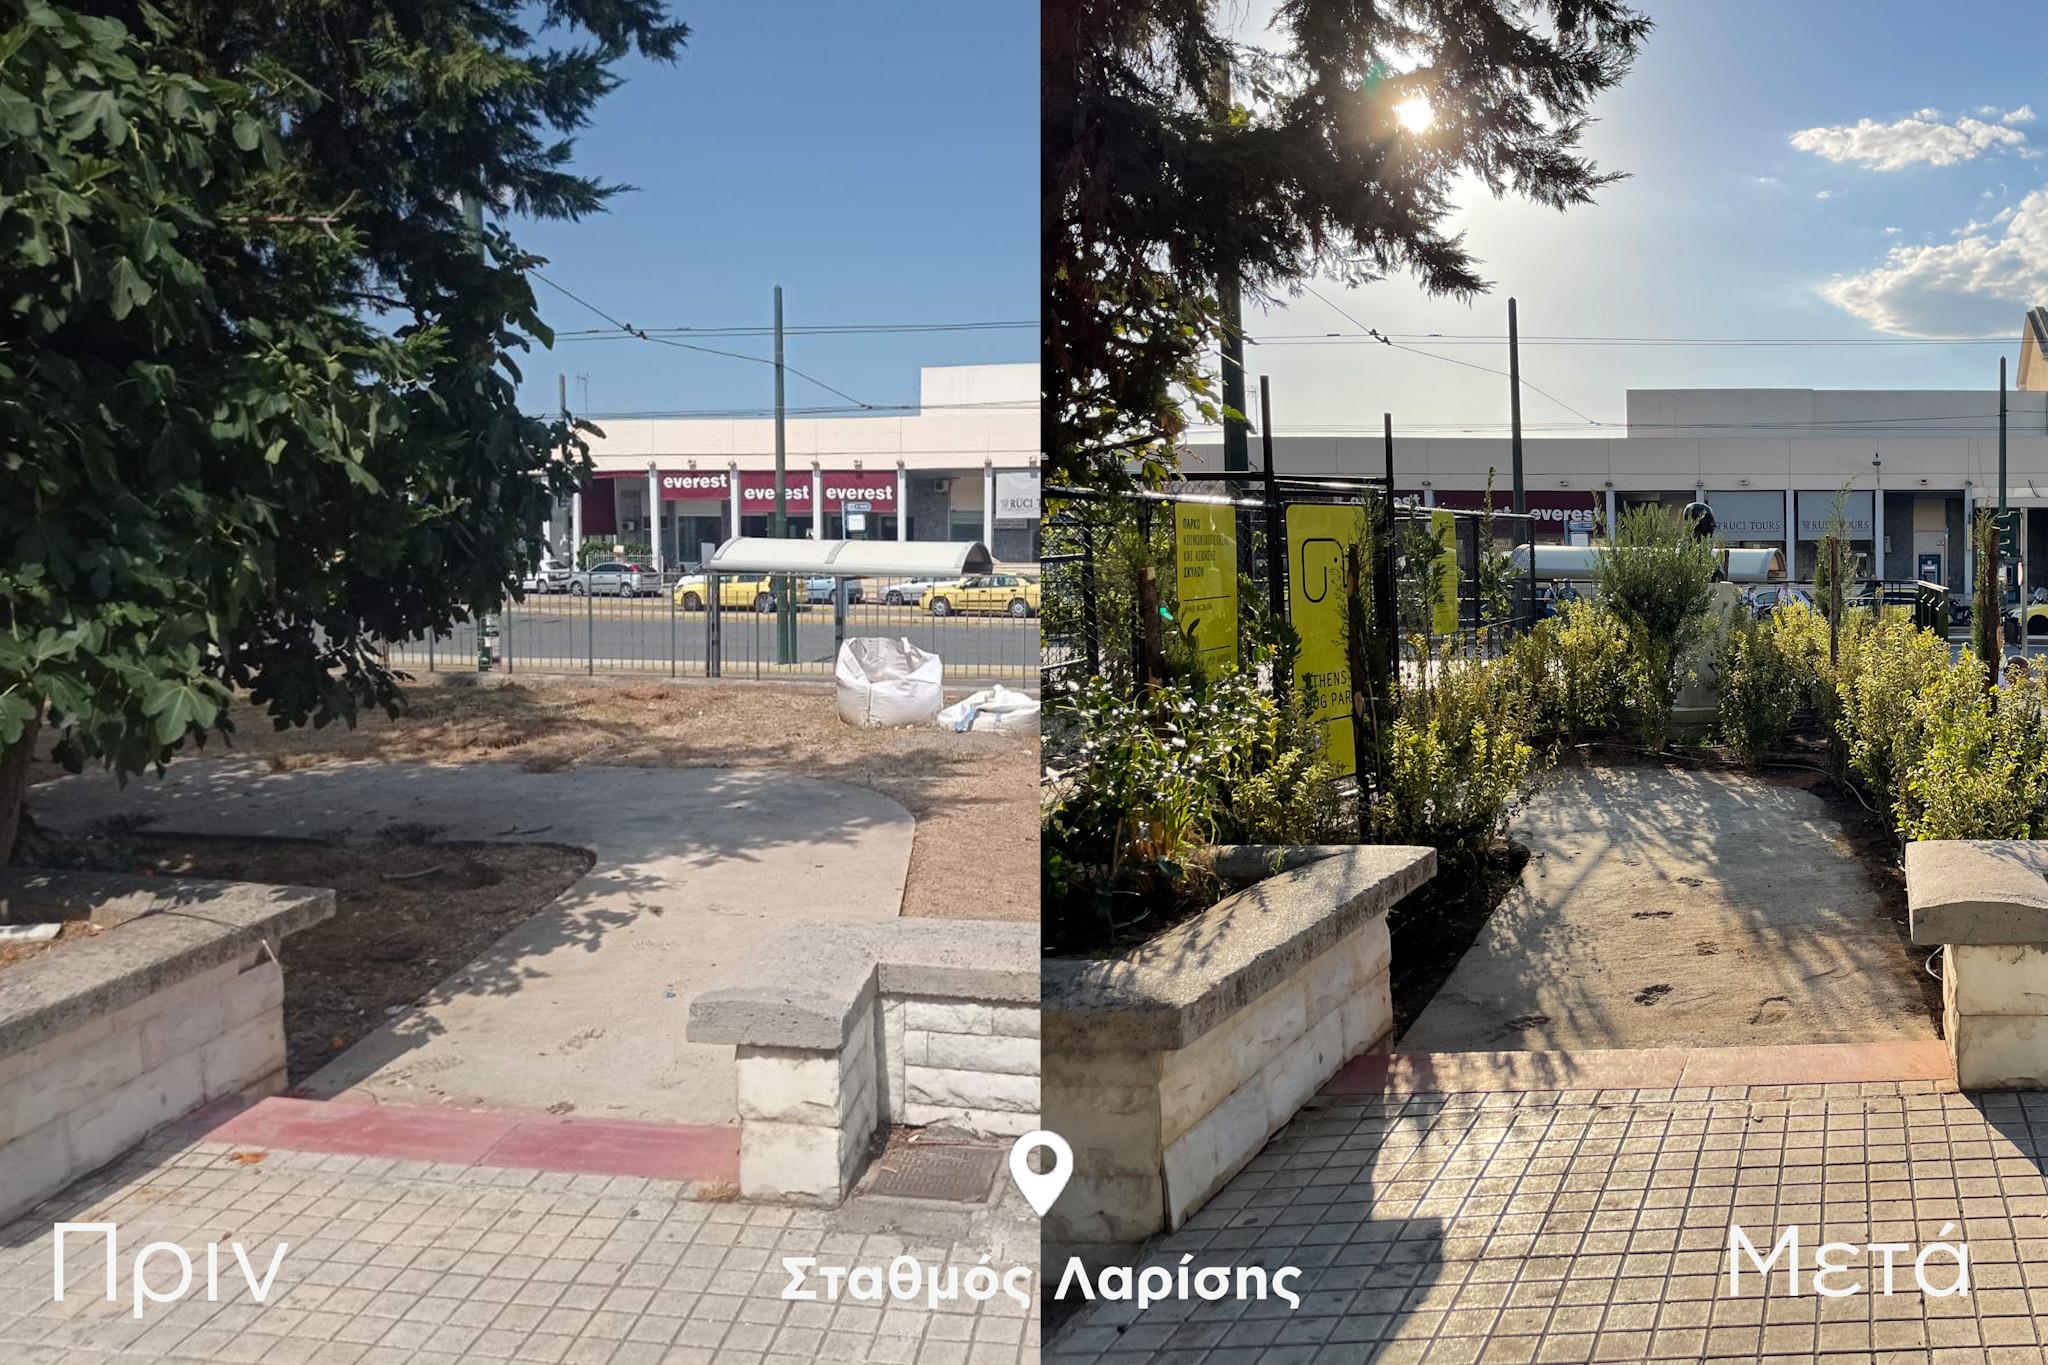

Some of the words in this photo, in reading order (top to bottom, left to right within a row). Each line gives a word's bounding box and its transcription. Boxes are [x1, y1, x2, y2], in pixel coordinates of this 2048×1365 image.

[663, 474, 727, 488] everest
[744, 485, 809, 499] eveest
[826, 485, 893, 500] everest
[1723, 521, 1746, 530] RUCI
[1750, 521, 1781, 530] TOURS
[1308, 670, 1347, 689] THENS
[1310, 694, 1327, 710] OG
[1331, 690, 1352, 707] PAR
